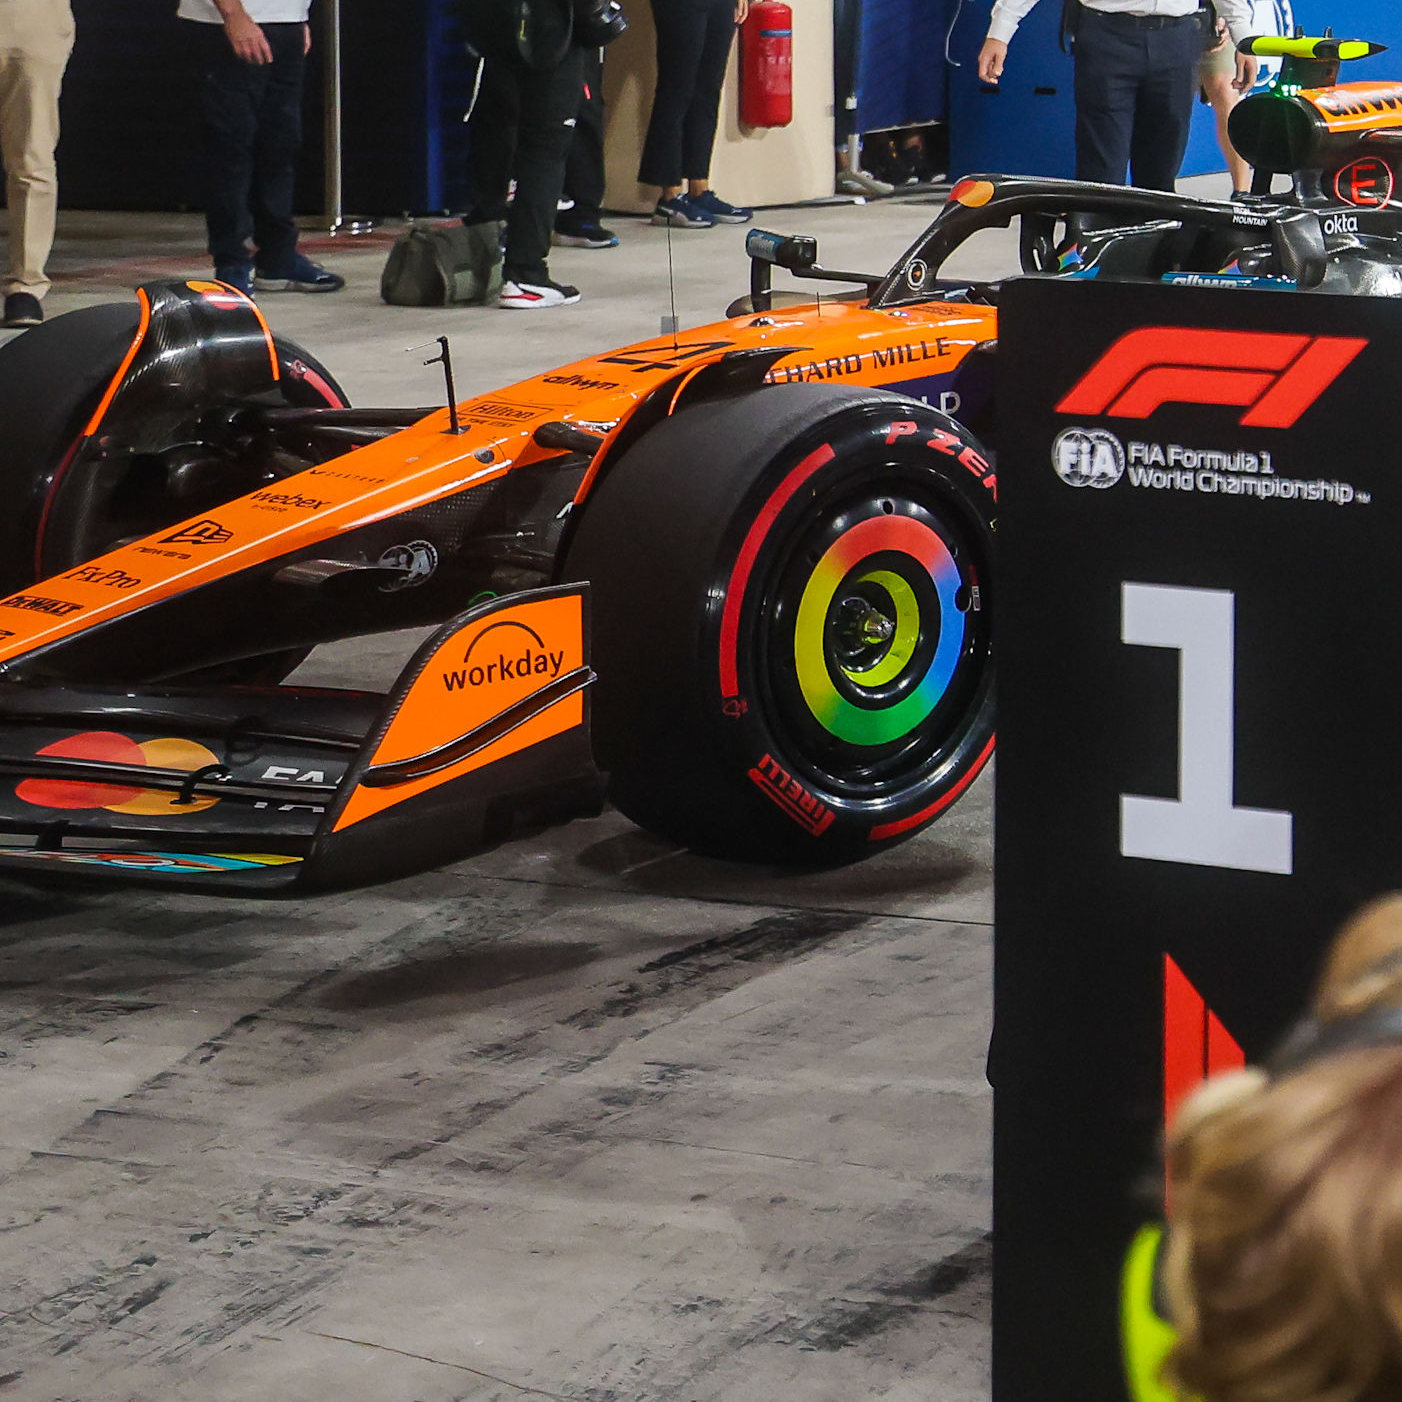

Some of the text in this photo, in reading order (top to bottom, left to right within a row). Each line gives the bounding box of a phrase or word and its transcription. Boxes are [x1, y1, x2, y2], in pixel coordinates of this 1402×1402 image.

[1324, 214, 1359, 236] okta
[873, 336, 952, 370] MILLE
[542, 374, 619, 391] allwyn
[469, 403, 536, 420] Hilton
[885, 421, 918, 445] P
[1127, 442, 1274, 474] FIA Formula 1
[251, 490, 332, 510] webex
[1127, 467, 1354, 506] World Championship
[61, 566, 142, 589] FxPro
[442, 648, 565, 692] workday
[1119, 579, 1293, 875] 1
[747, 752, 837, 837] PIRELLI
